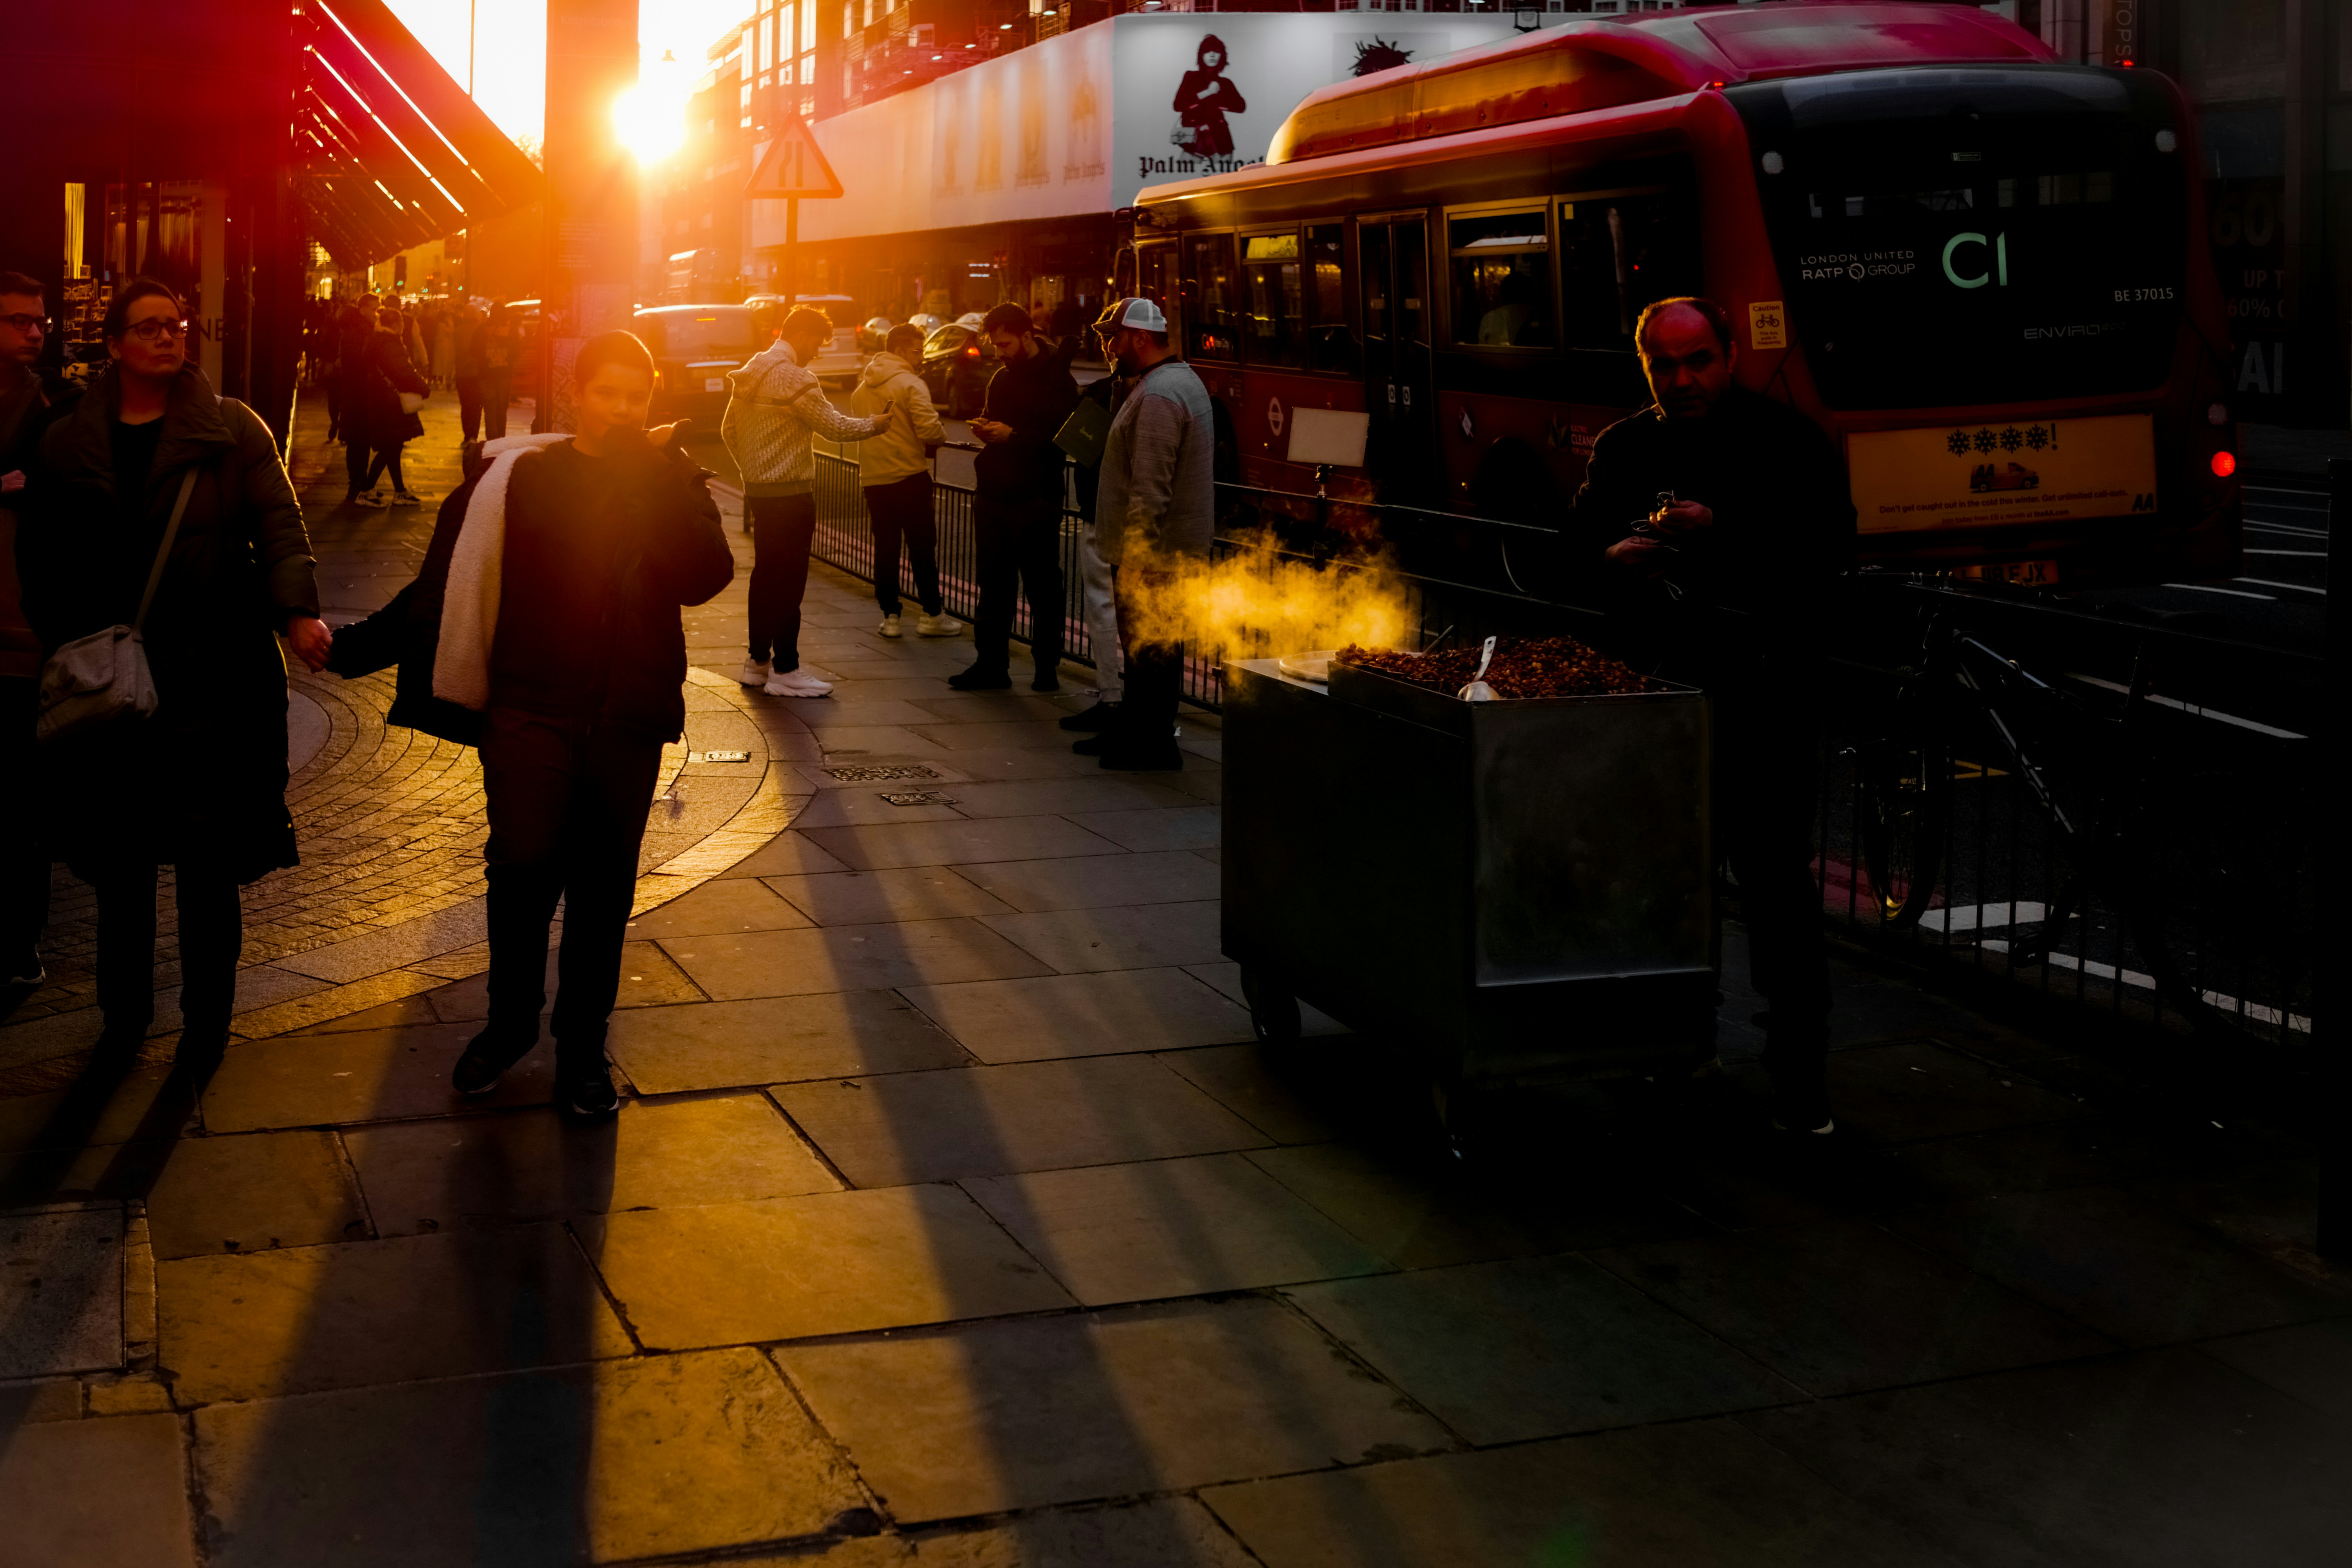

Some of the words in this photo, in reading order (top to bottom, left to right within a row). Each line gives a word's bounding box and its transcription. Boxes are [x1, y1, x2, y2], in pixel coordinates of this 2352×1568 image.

[1138, 156, 1195, 179] Palm
[1800, 254, 1857, 265] LONDON
[1864, 250, 1914, 260] UNITED
[1802, 267, 1843, 280] RATP
[1867, 263, 1915, 276] GROUP
[2244, 269, 2267, 289] UP
[2274, 269, 2284, 289] T
[2114, 290, 2131, 302] BE
[2134, 287, 2174, 301] 37015
[2227, 298, 2270, 319] 60%
[1976, 464, 1994, 479] AA
[1880, 505, 1900, 513] Don't
[1902, 505, 1914, 513] get
[1916, 502, 1942, 511] caught
[1982, 498, 1998, 506] cold
[2000, 496, 2013, 505] this
[2014, 495, 2040, 504] winter.
[2057, 491, 2092, 501] unlimited
[2132, 493, 2154, 511] AA
